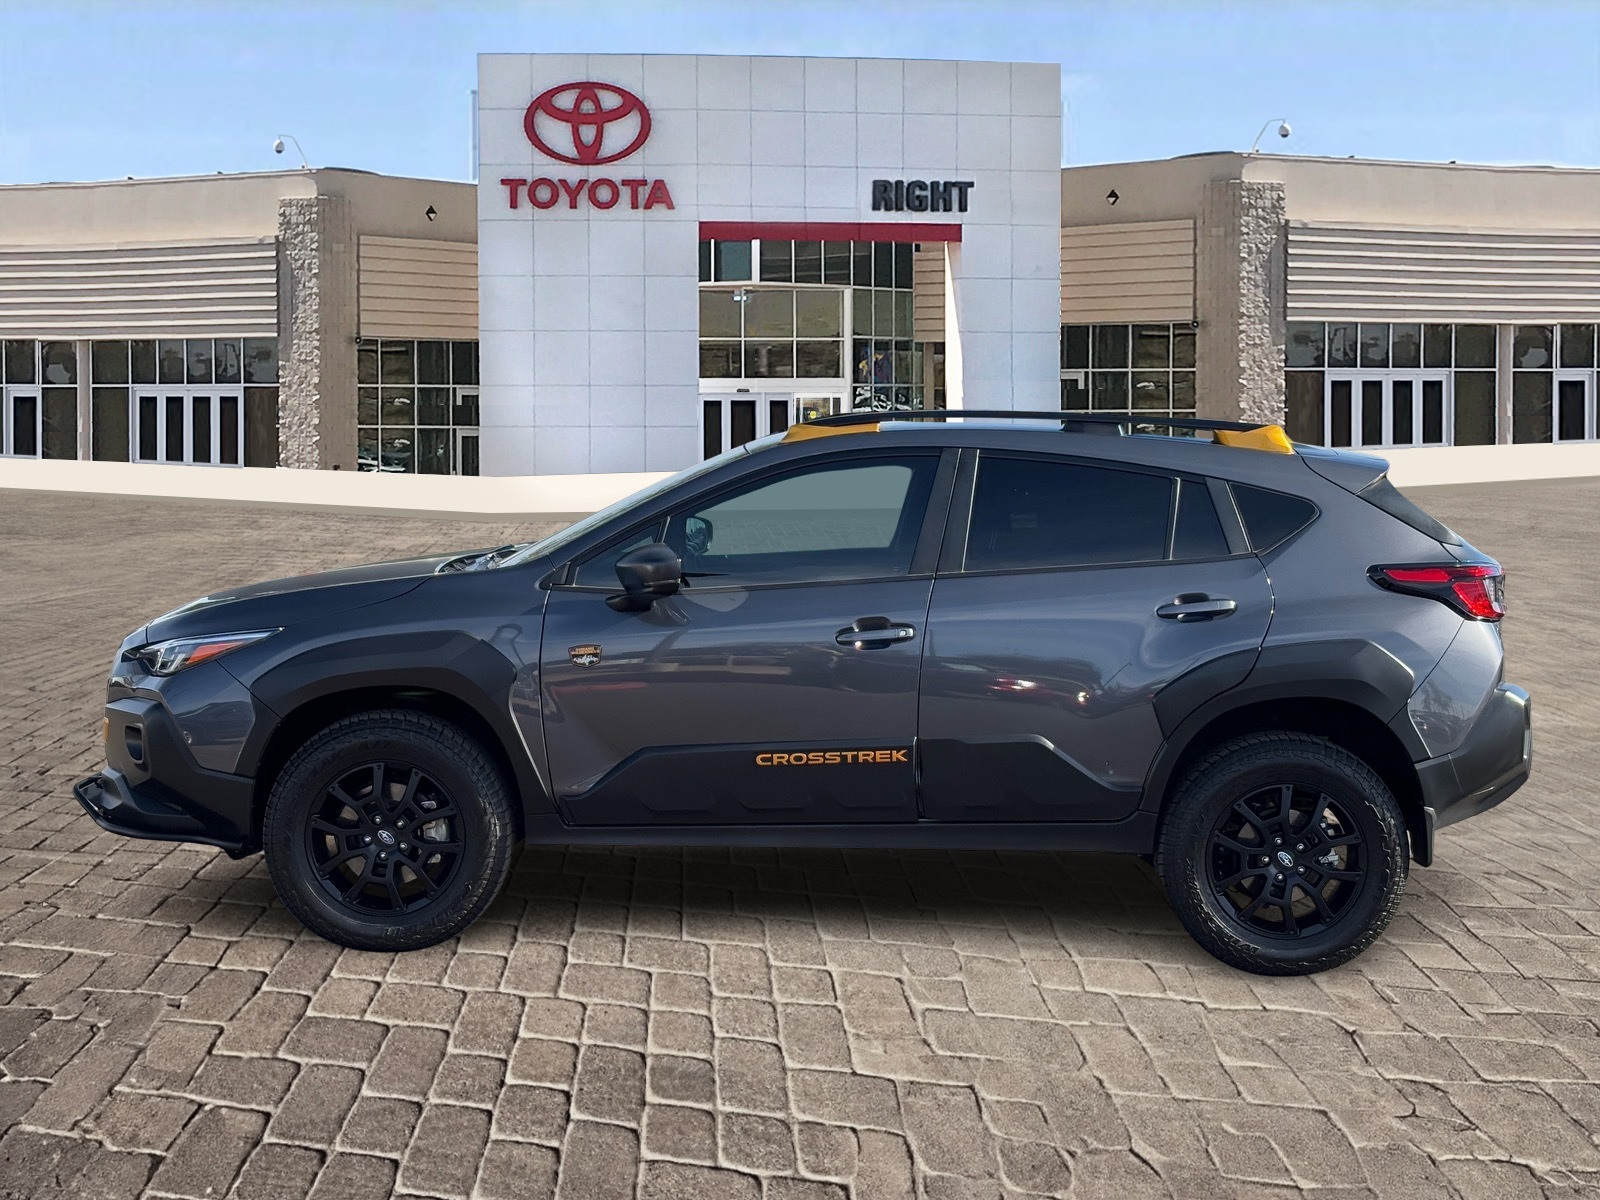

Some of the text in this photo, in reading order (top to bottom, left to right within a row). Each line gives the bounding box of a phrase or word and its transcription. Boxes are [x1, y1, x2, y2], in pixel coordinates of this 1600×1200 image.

[500, 178, 675, 210] TOYOTA
[872, 180, 975, 212] RIGHT
[755, 750, 908, 766] CROSSTREK
